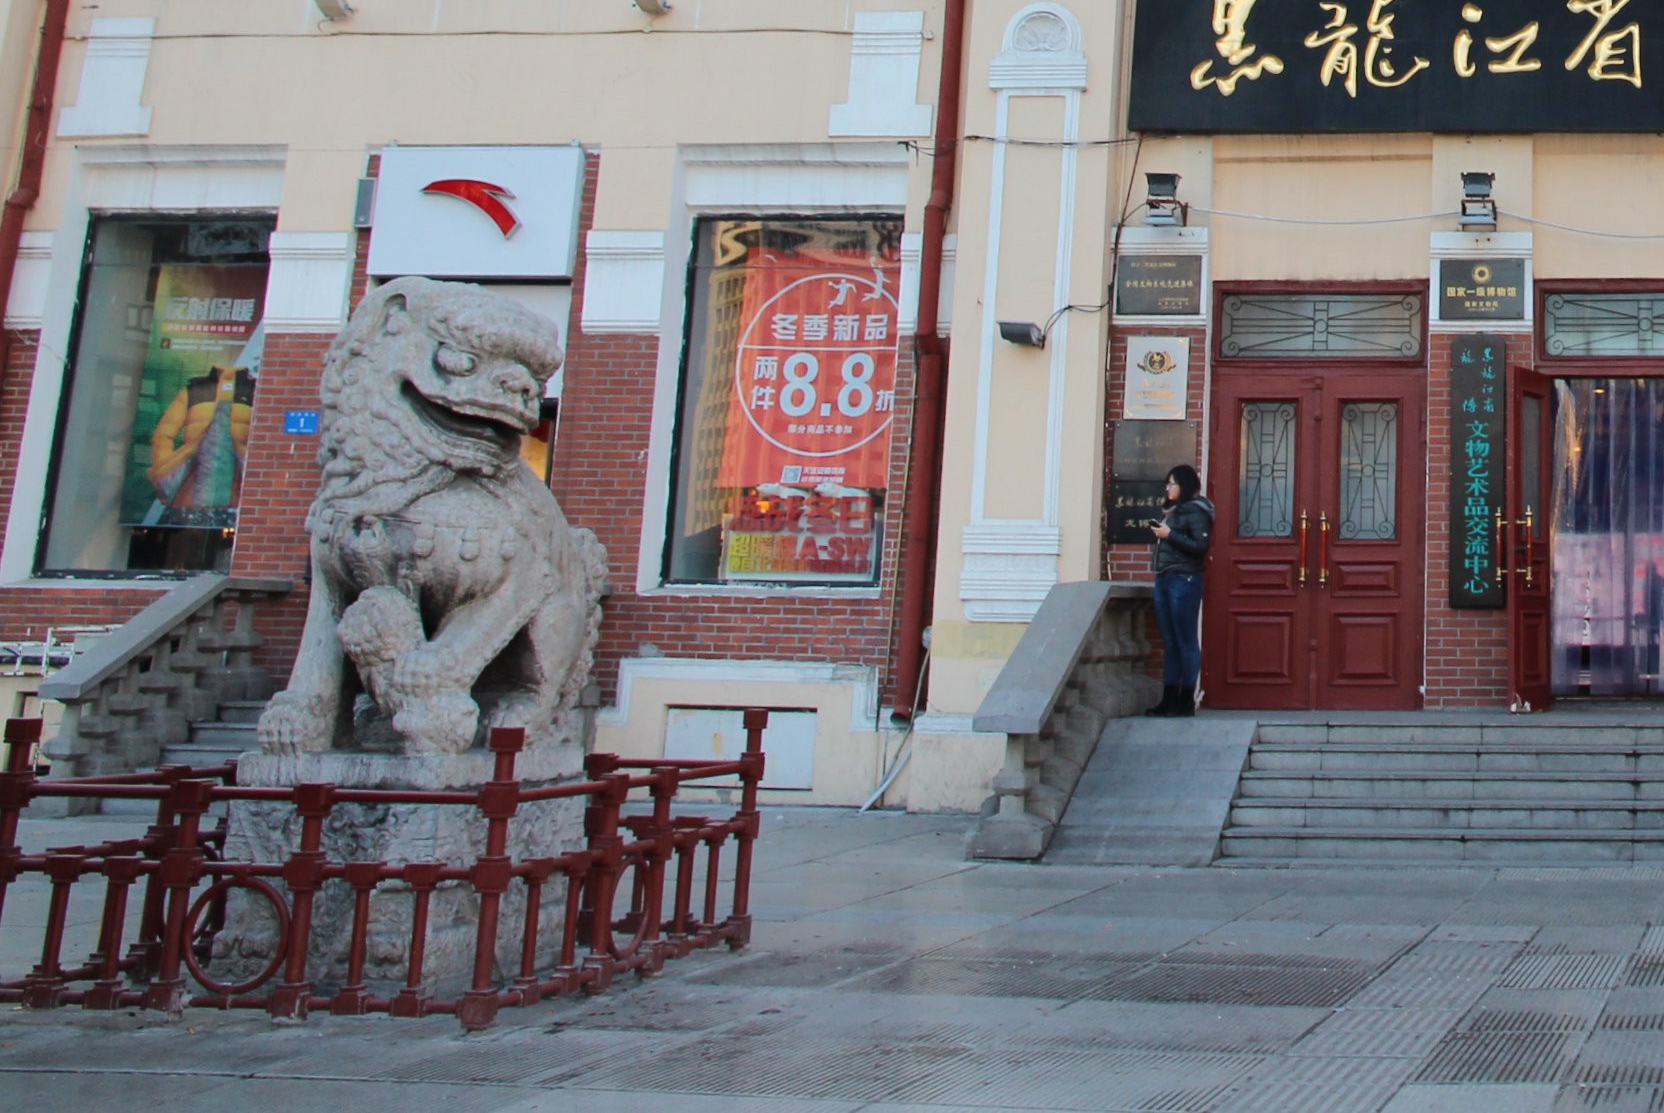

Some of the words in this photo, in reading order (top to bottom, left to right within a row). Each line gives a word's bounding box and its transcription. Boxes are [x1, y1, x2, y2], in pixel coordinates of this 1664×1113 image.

[1446, 286, 1517, 297] 国家一级博物馆
[771, 313, 888, 341] 冬季新品
[751, 356, 778, 410] 两件
[1464, 420, 1491, 593] 文物艺术品交流中心
